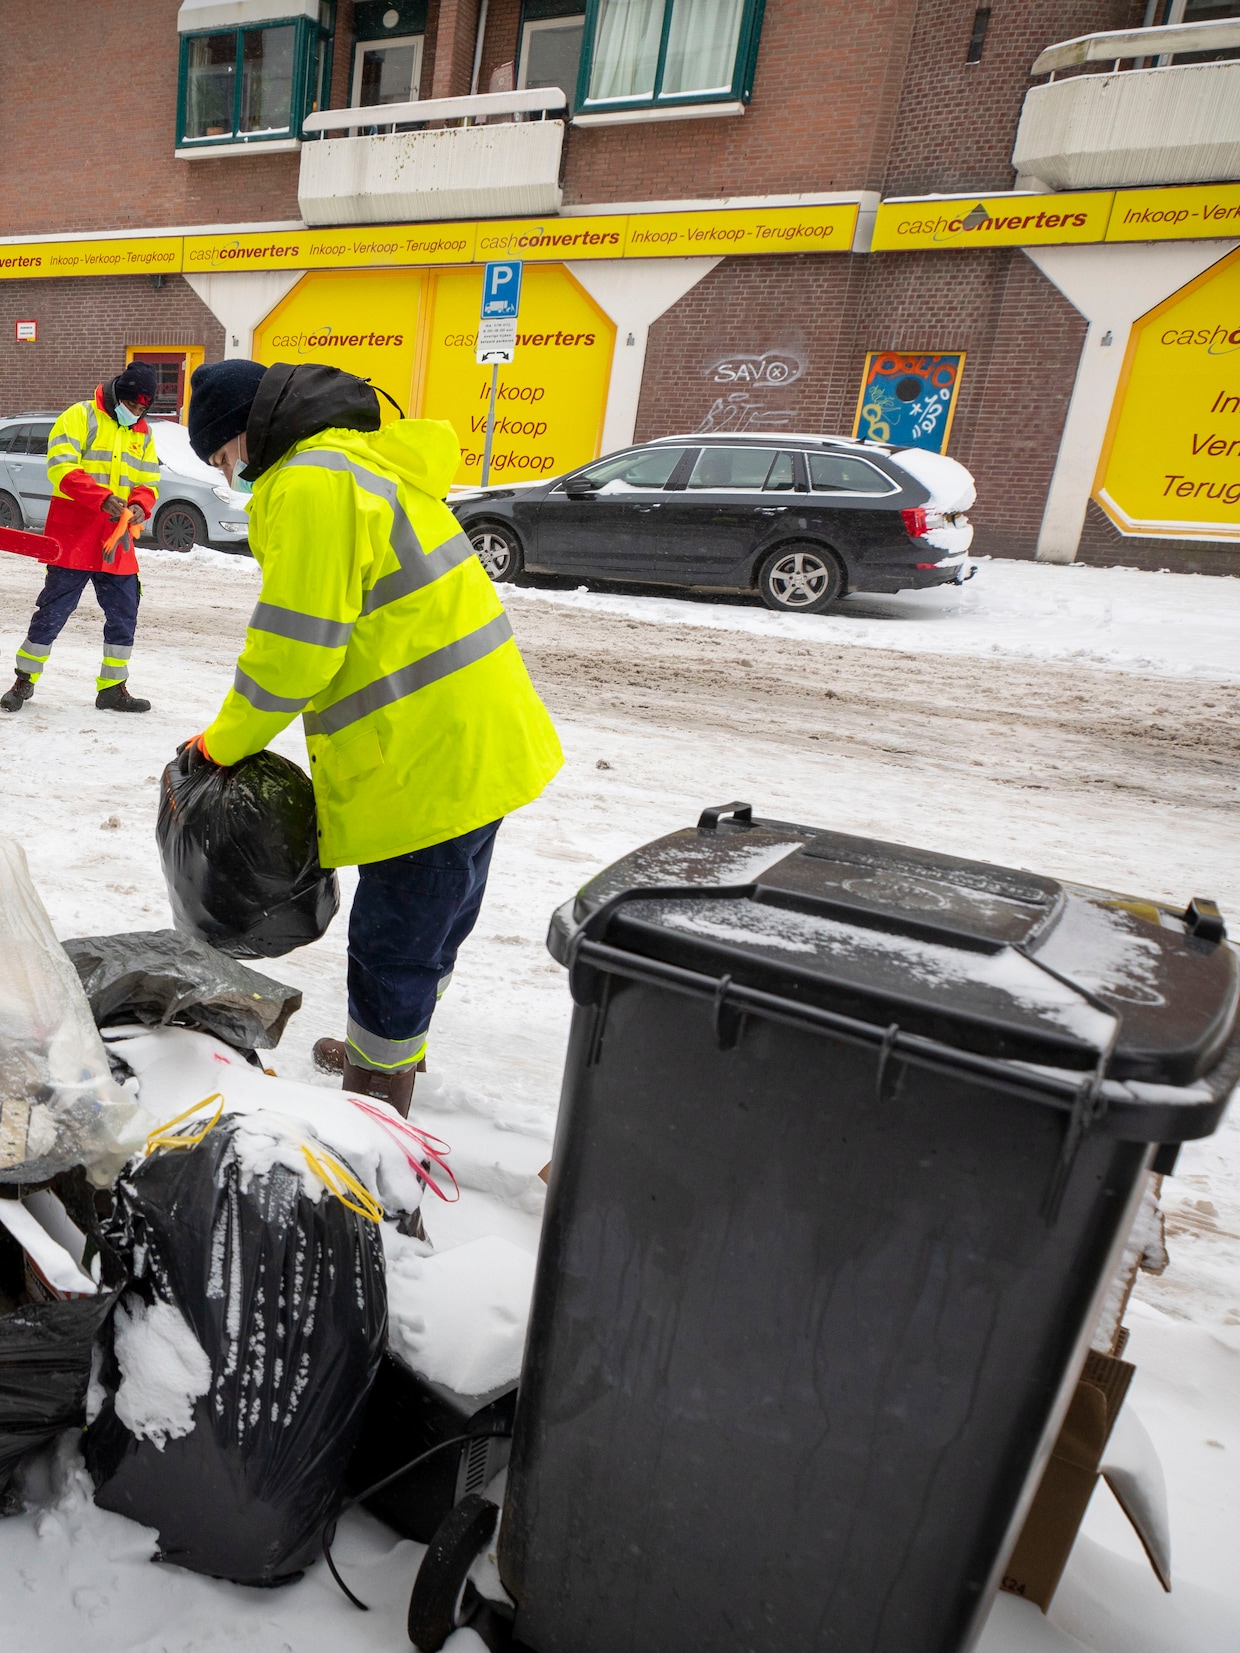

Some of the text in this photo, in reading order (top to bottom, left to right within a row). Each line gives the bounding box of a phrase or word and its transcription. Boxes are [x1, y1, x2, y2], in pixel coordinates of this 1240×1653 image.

[897, 211, 1088, 235] cashcnverters
[480, 231, 620, 250] cashconverters
[189, 244, 300, 261] cashconverters
[491, 266, 513, 295] P
[272, 332, 403, 347] cashconverters
